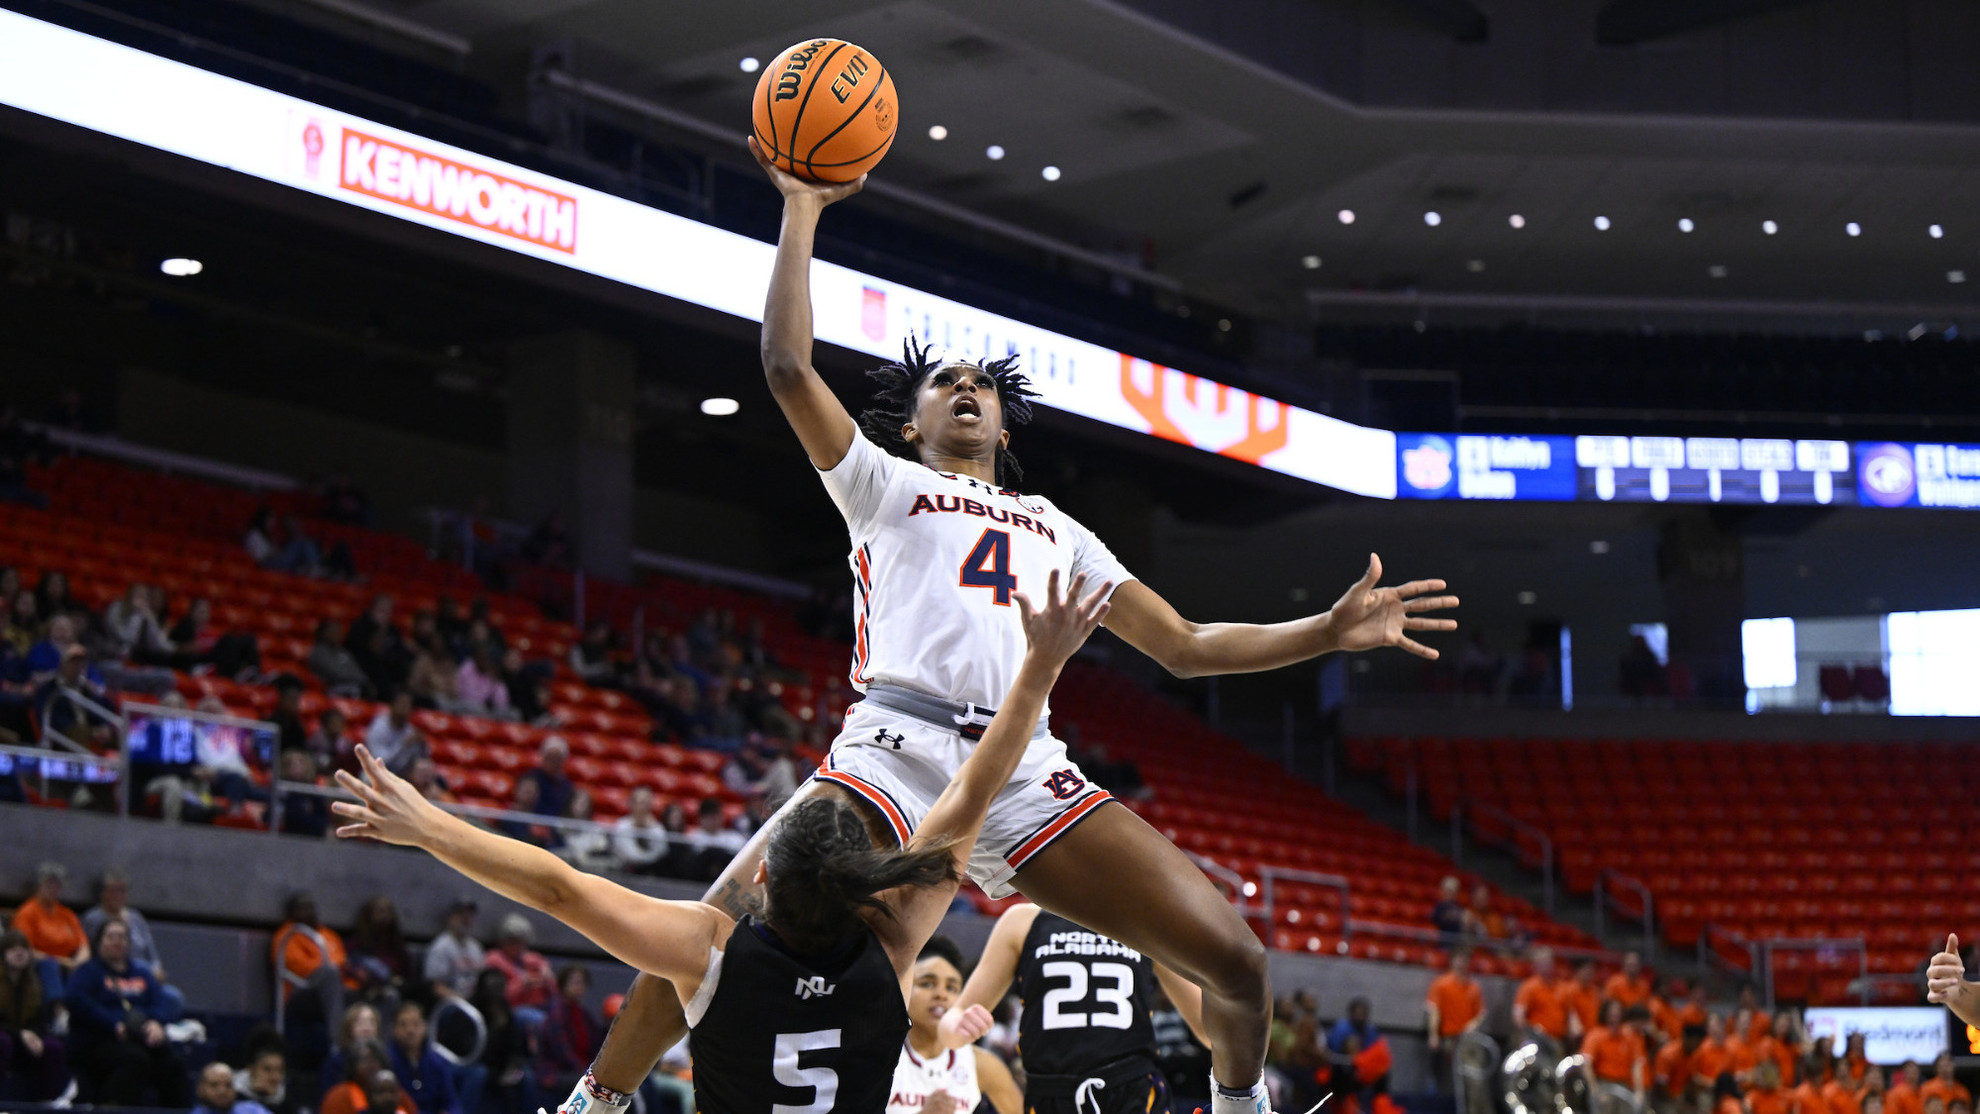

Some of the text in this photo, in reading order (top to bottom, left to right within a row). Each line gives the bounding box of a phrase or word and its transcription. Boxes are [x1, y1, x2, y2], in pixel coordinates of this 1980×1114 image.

[775, 40, 830, 102] Wilso
[344, 135, 575, 249] KENWORTH
[908, 494, 1057, 546] AUBURN
[959, 527, 1018, 607] 4
[1035, 942, 1142, 963] ALABAMA
[1050, 931, 1121, 946] NORT
[1042, 961, 1135, 1031] 23
[772, 1028, 842, 1114] 5
